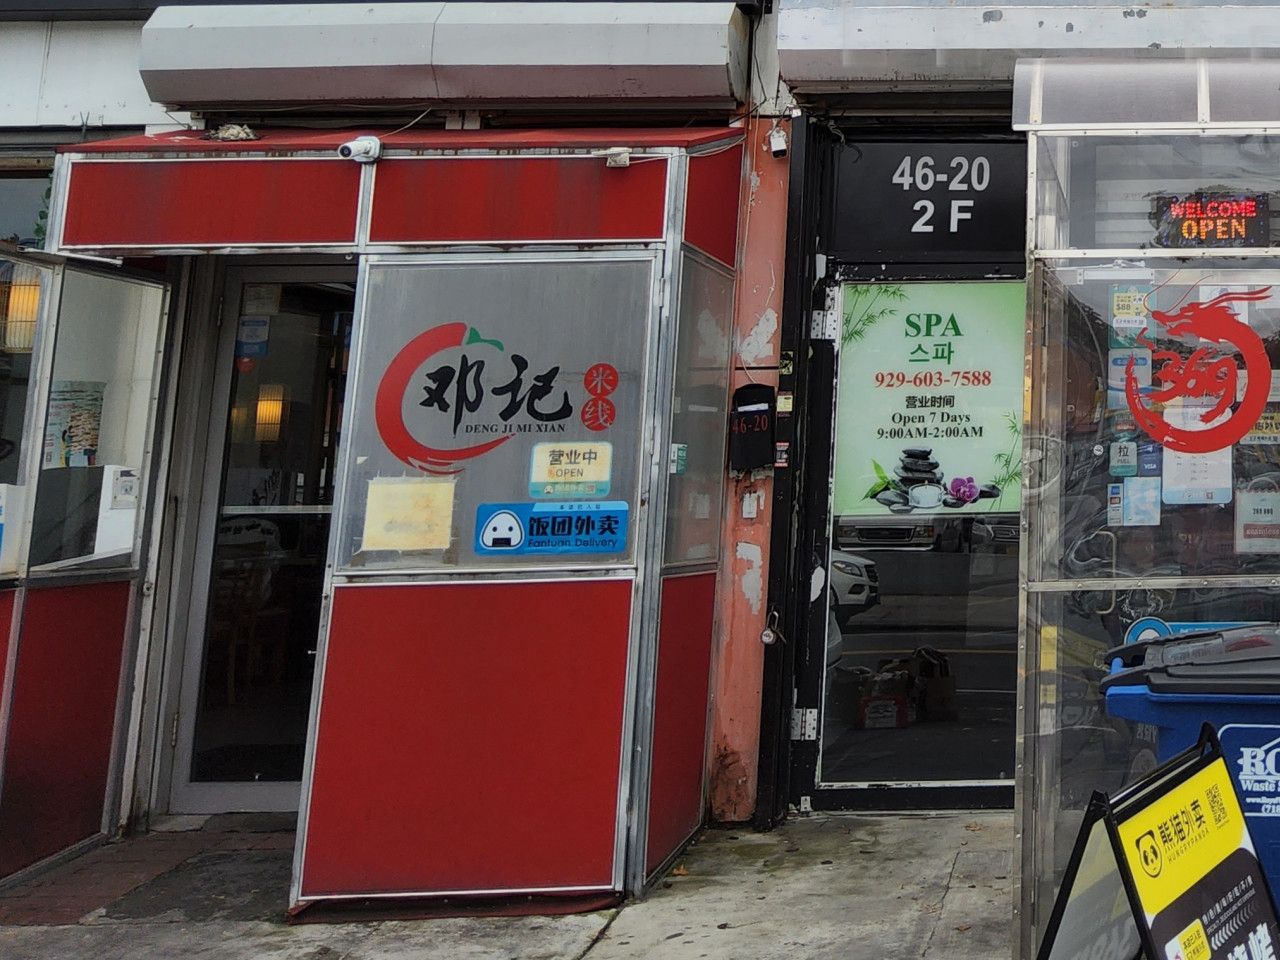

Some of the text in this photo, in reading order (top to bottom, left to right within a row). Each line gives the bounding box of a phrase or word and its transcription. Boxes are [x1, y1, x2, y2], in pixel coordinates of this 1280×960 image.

[891, 155, 991, 191] 46-20
[911, 200, 974, 233] 2 F
[1169, 200, 1257, 218] WELCOME
[1181, 219, 1247, 240] OPEN
[904, 313, 964, 337] SPA
[908, 342, 955, 365] 스파
[874, 370, 992, 388] 929-603-7588
[905, 395, 956, 409] 营业时间
[732, 414, 769, 435] 46-20
[891, 411, 971, 427] Open 7 Days
[465, 423, 566, 434] DENG JI MI XIAN
[876, 426, 984, 440] 9:00AM-2:00AM
[548, 448, 598, 466] 营业中
[555, 468, 584, 478] OPEN
[528, 515, 620, 537] 饭团外卖
[1240, 780, 1276, 792] Waste
[1157, 799, 1206, 845] 熊猫外卖
